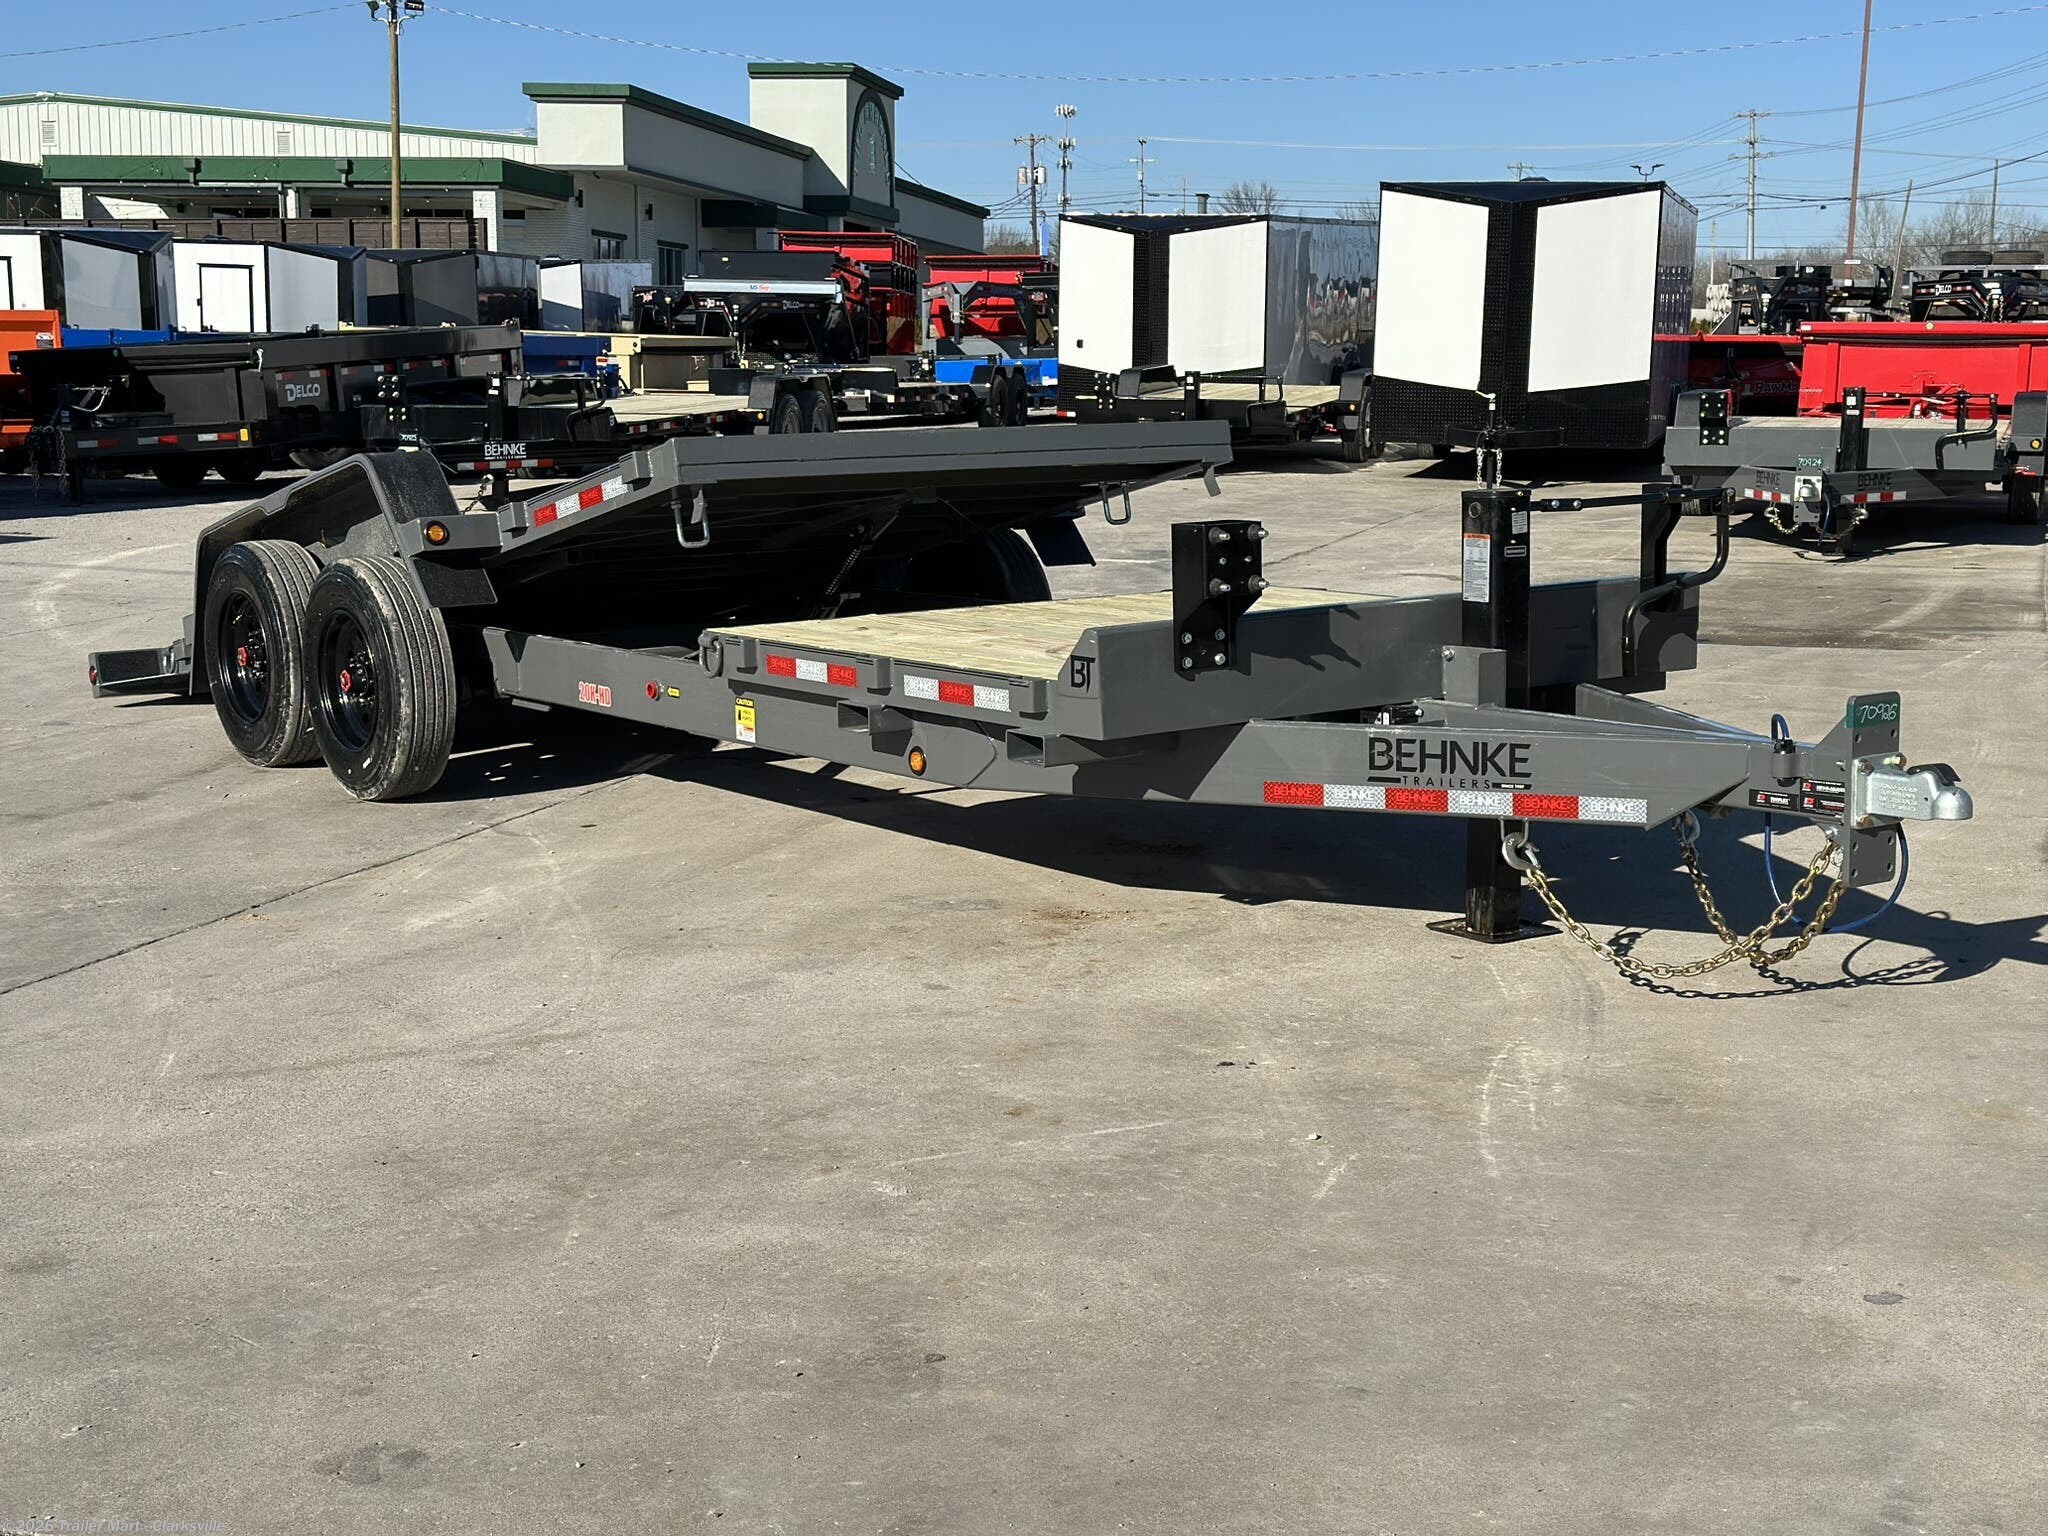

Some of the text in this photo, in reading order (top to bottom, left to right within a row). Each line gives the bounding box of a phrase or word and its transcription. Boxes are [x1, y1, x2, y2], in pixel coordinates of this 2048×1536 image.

[285, 383, 320, 401] DELCO
[484, 443, 527, 456] BEHNKE
[1798, 458, 1822, 467] 70924
[1756, 470, 1780, 486] BEHNKE
[1857, 472, 1893, 487] BEHNKE
[579, 681, 612, 707] 20K-HD
[1368, 736, 1532, 778] BEHNKE
[1402, 775, 1490, 789] TRAILERS
[1273, 786, 1635, 814] BEHNKE BEHNKE BEHNKE BEHNKE BEHNKE BEHNKE
